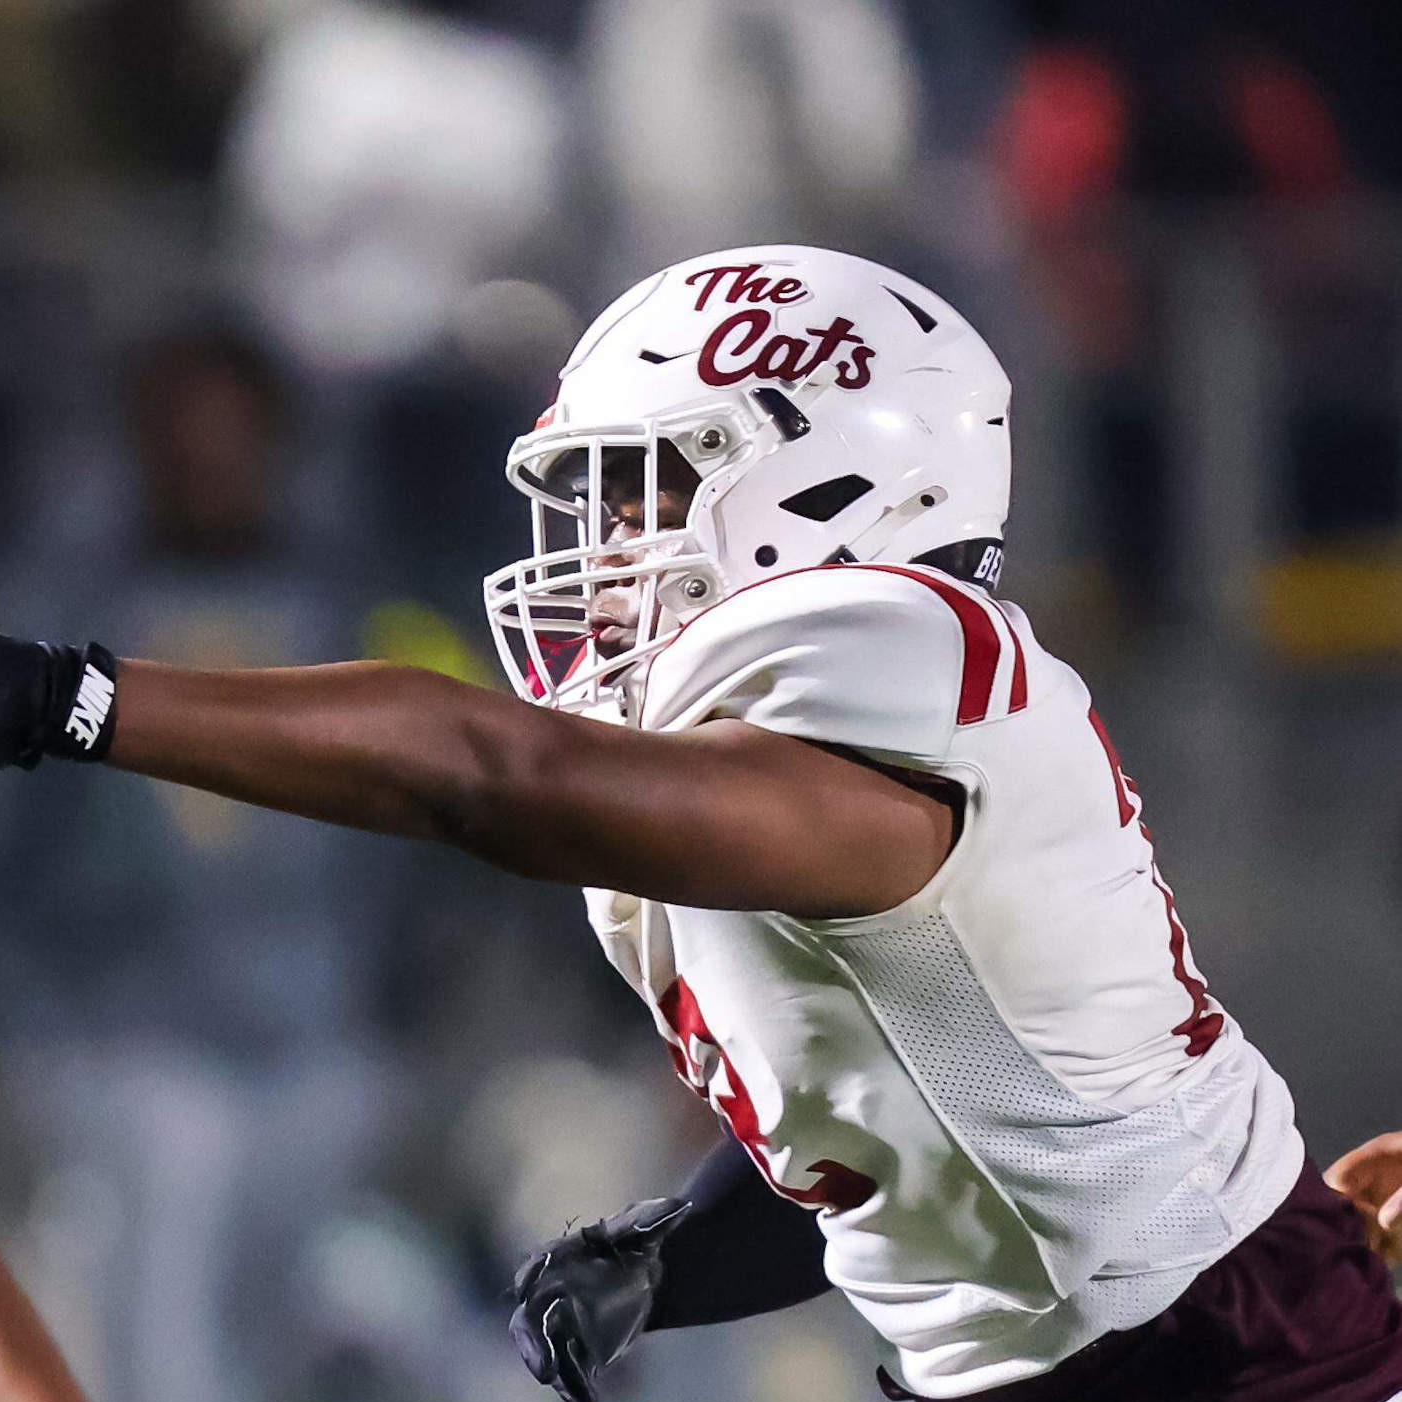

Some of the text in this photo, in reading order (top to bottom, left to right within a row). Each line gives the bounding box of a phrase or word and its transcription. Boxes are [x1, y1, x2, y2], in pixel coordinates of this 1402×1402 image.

[685, 263, 809, 312] The
[697, 308, 877, 390] Cats
[64, 662, 115, 751] NIKE
